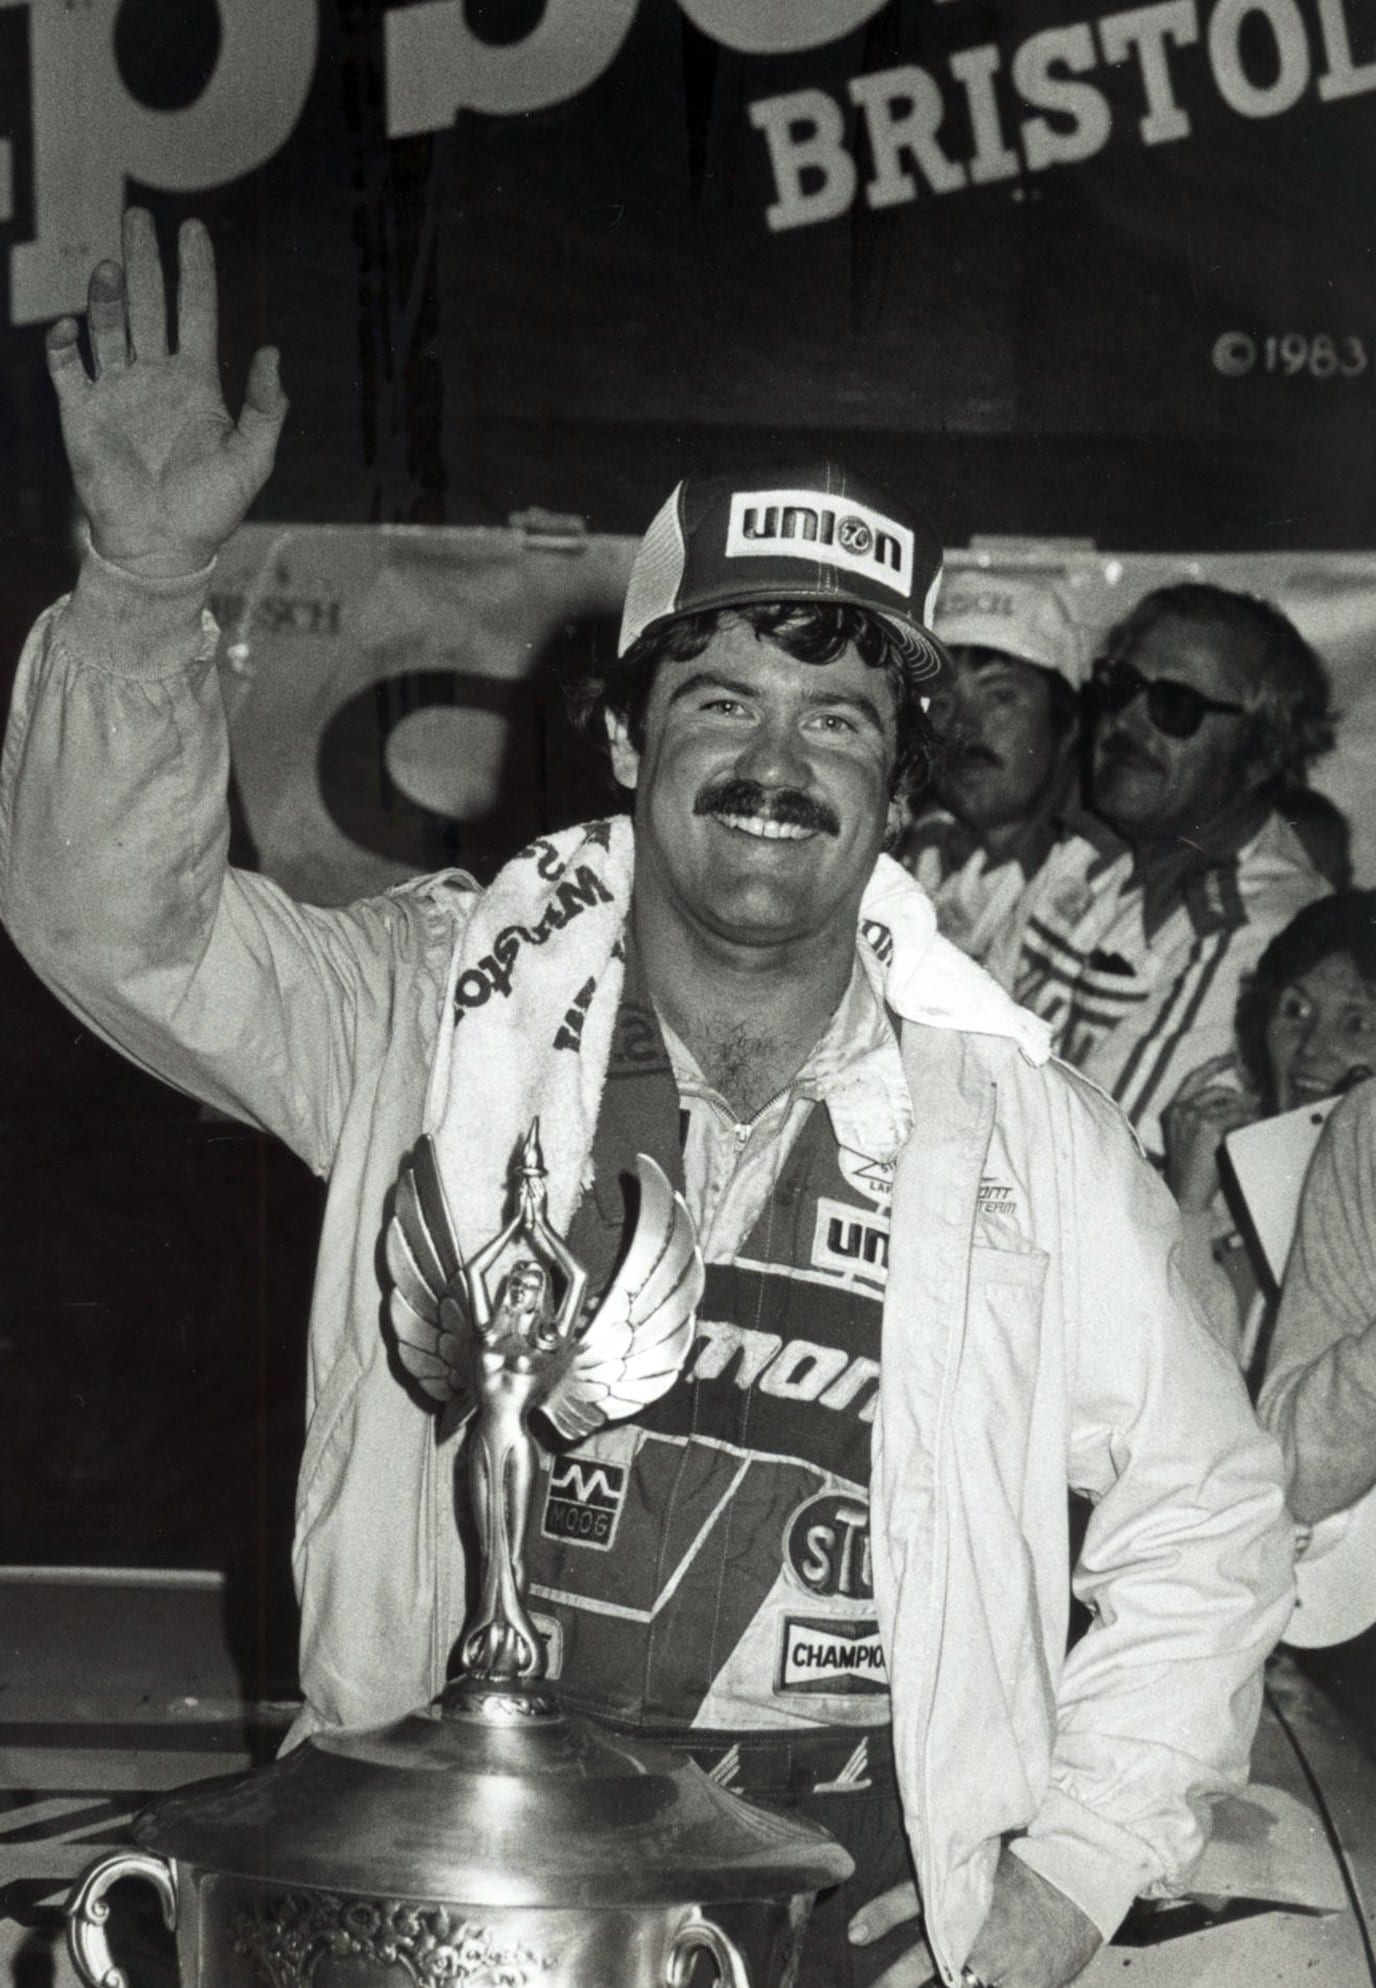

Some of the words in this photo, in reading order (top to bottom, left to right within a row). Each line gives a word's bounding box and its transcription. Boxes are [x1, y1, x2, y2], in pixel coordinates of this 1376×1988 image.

[749, 0, 1376, 232] BRISTOL
[453, 865, 614, 1026] Winsto
[827, 1217, 890, 1269] un
[684, 1320, 882, 1422] mon
[549, 1503, 609, 1537] MOOG
[792, 1642, 885, 1668] CHAMPIO
